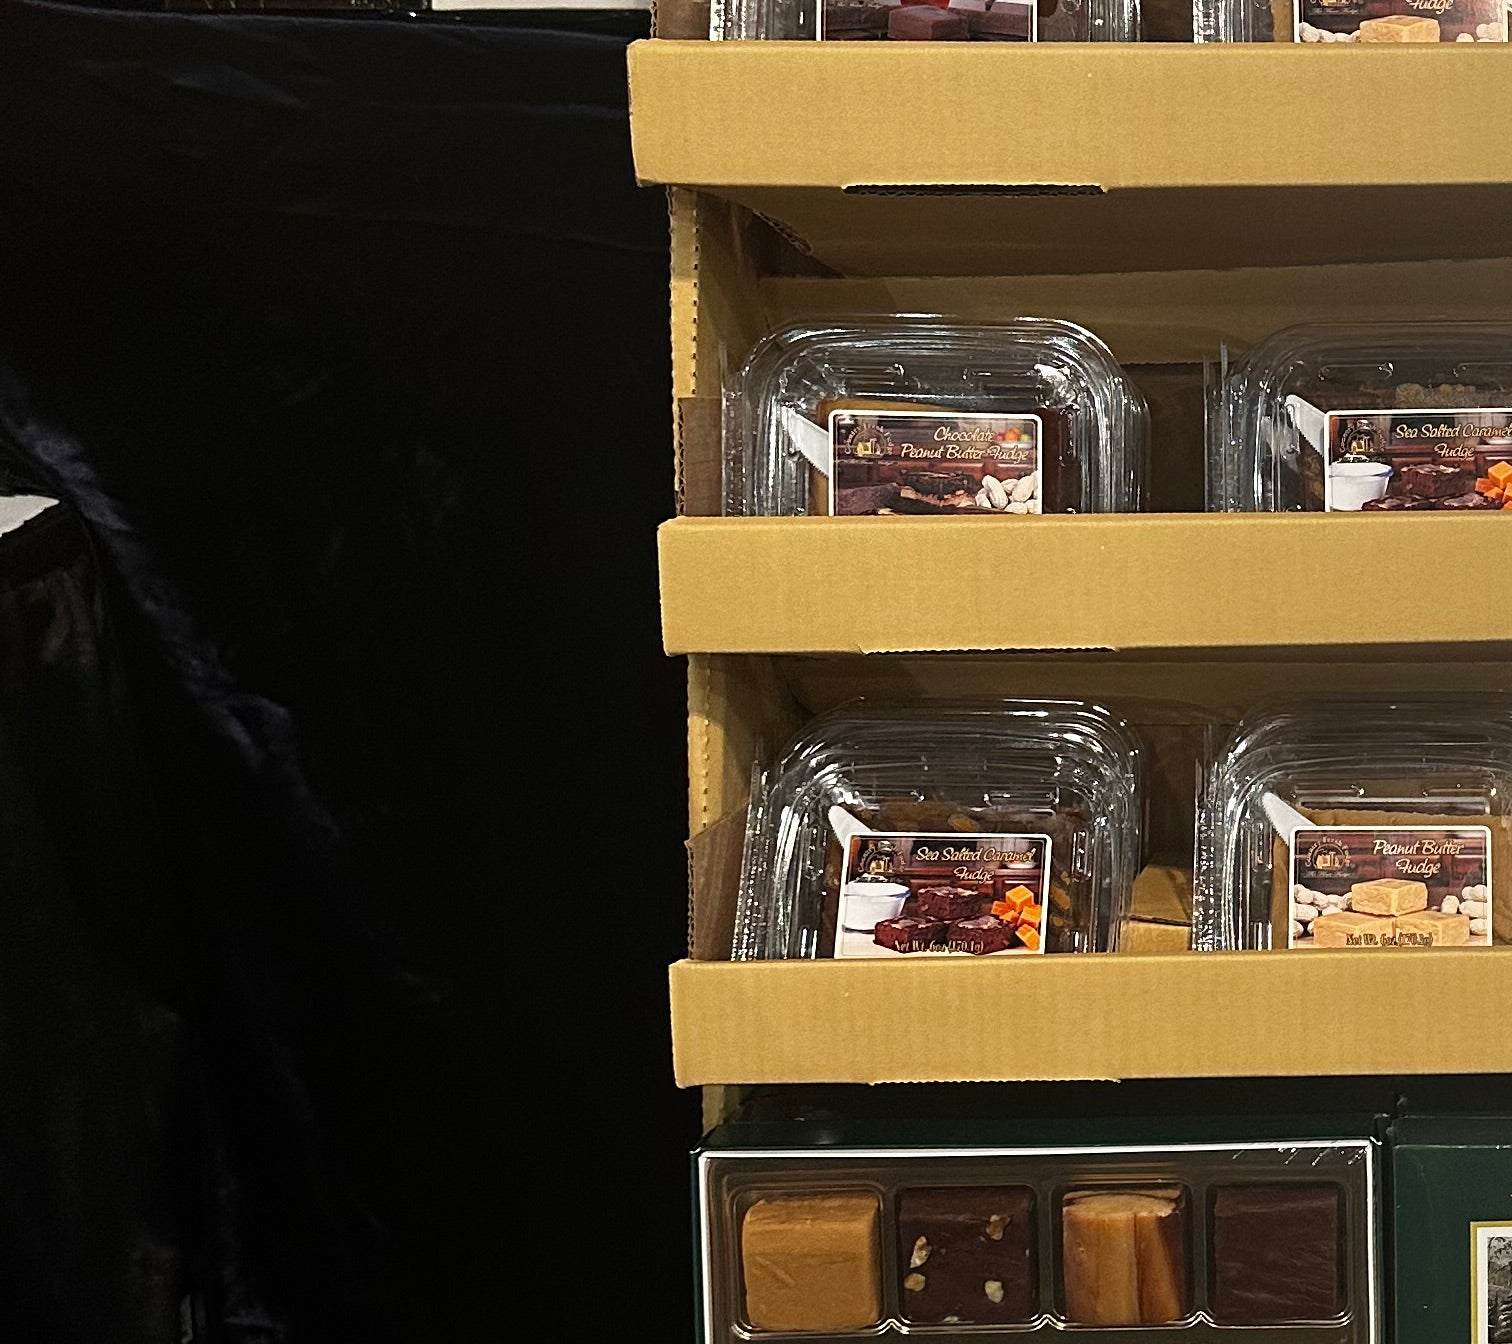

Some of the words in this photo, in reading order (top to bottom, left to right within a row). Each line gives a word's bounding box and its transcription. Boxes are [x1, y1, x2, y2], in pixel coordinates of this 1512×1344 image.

[933, 425, 996, 443] Chocolate
[1395, 423, 1420, 440] Sea
[1421, 422, 1462, 439] Salted
[900, 442, 946, 459] Peanut
[945, 444, 986, 460] Butter
[986, 444, 1029, 464] Fudge
[1434, 442, 1476, 461] Fudge
[916, 847, 940, 862] Sea
[941, 846, 984, 862] Salted
[983, 846, 1036, 862] Caramel
[1372, 839, 1420, 856] Peanut
[1421, 839, 1465, 856] Butter
[953, 866, 995, 884] Fudge
[1395, 858, 1442, 879] Fudge
